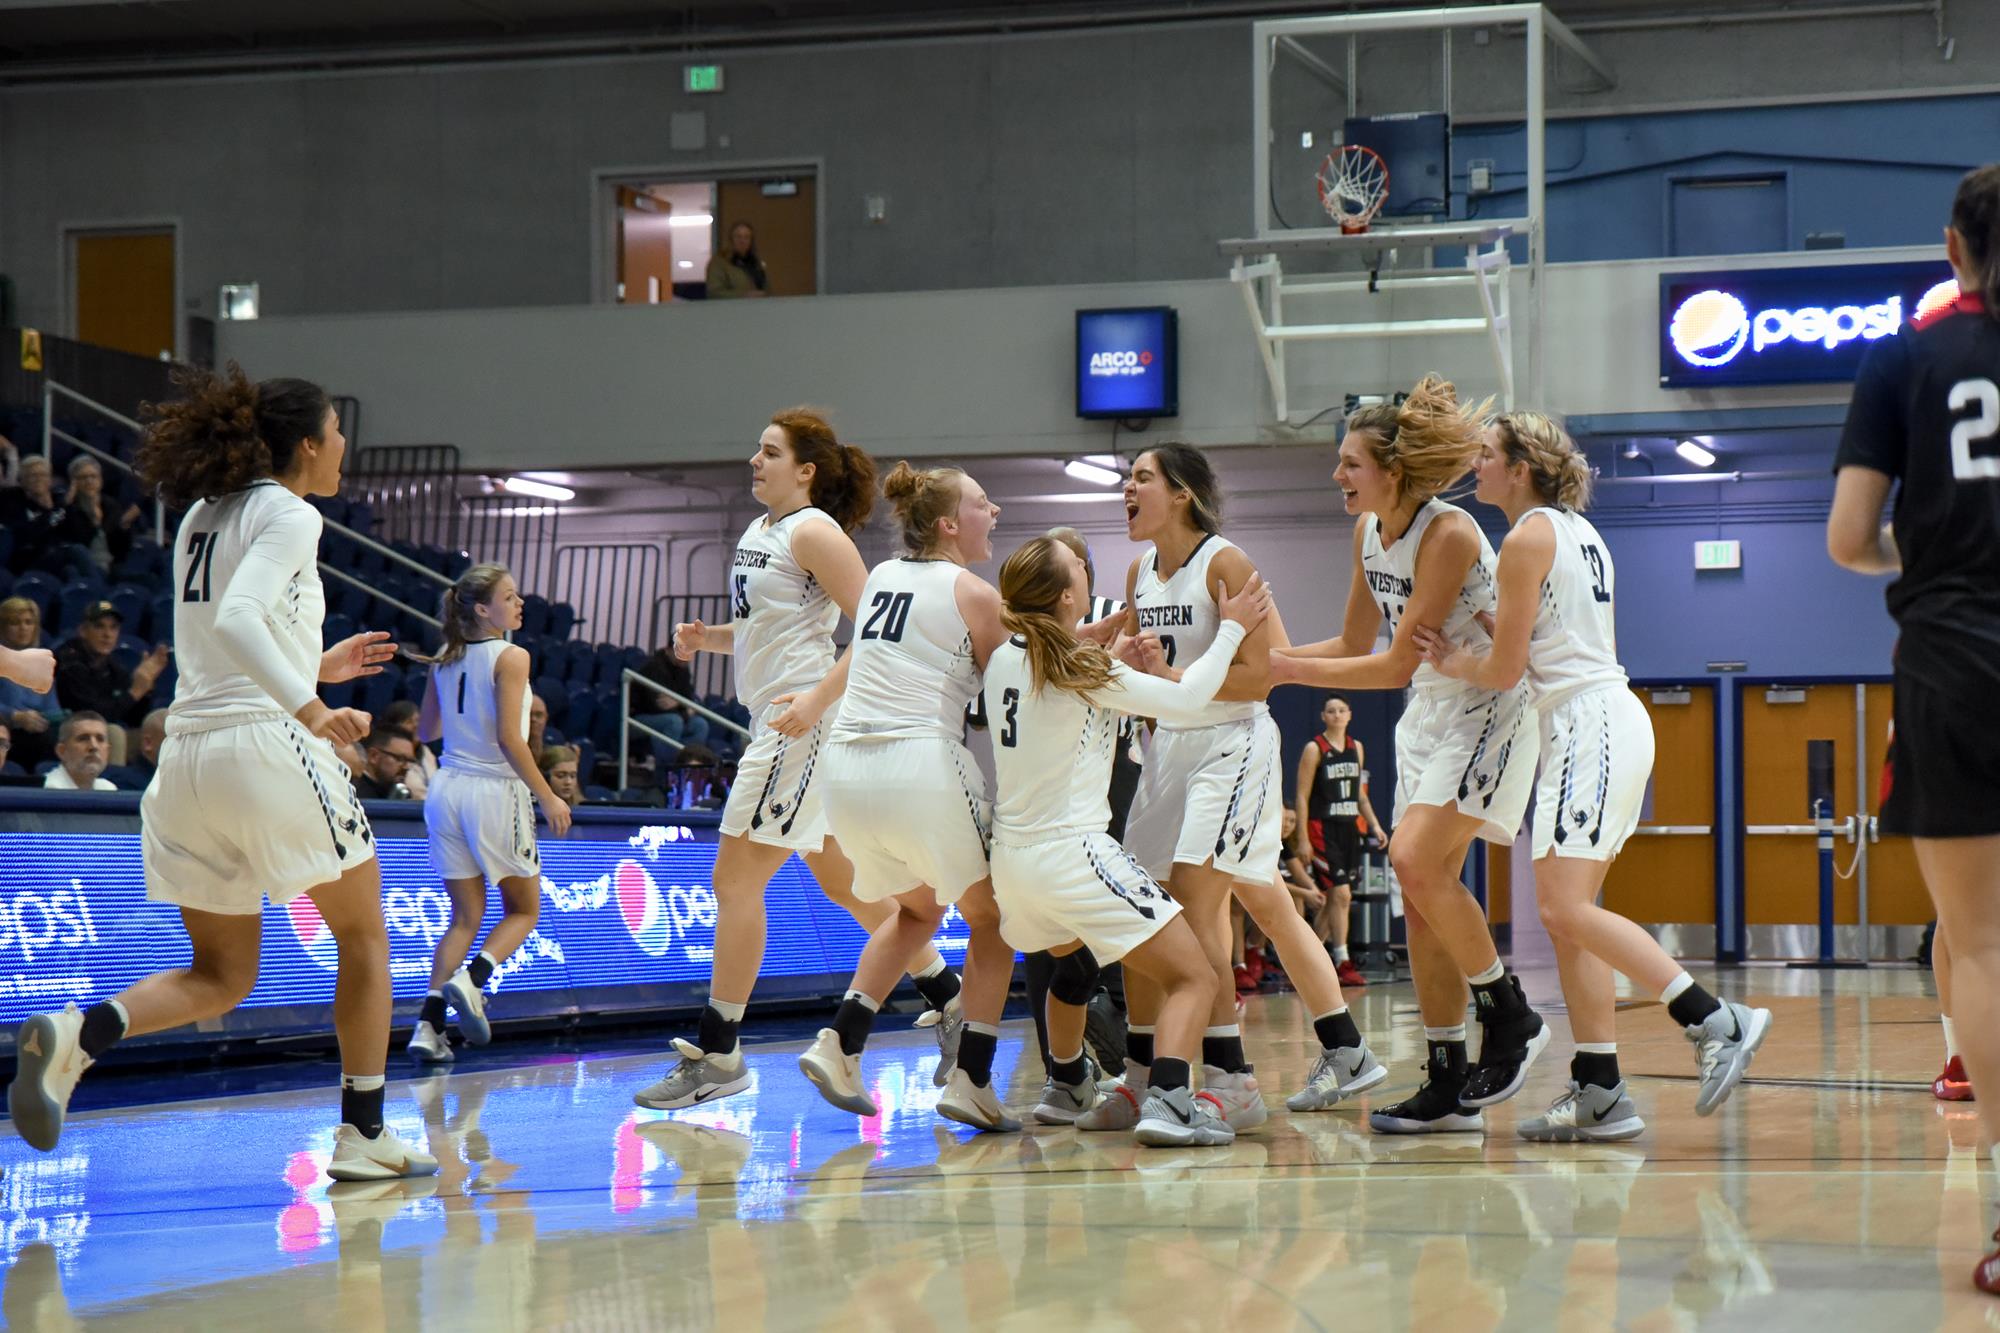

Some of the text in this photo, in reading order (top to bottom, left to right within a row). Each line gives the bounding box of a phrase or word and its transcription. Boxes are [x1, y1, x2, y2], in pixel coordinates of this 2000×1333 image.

[1754, 296, 1901, 353] pepsi
[1090, 351, 1138, 367] ARCO
[183, 531, 219, 602] 21
[735, 548, 771, 569] ESTERN
[861, 591, 914, 643] 20
[1137, 605, 1193, 628] ESTERN
[457, 671, 467, 715] 1
[1001, 687, 1020, 748] 3
